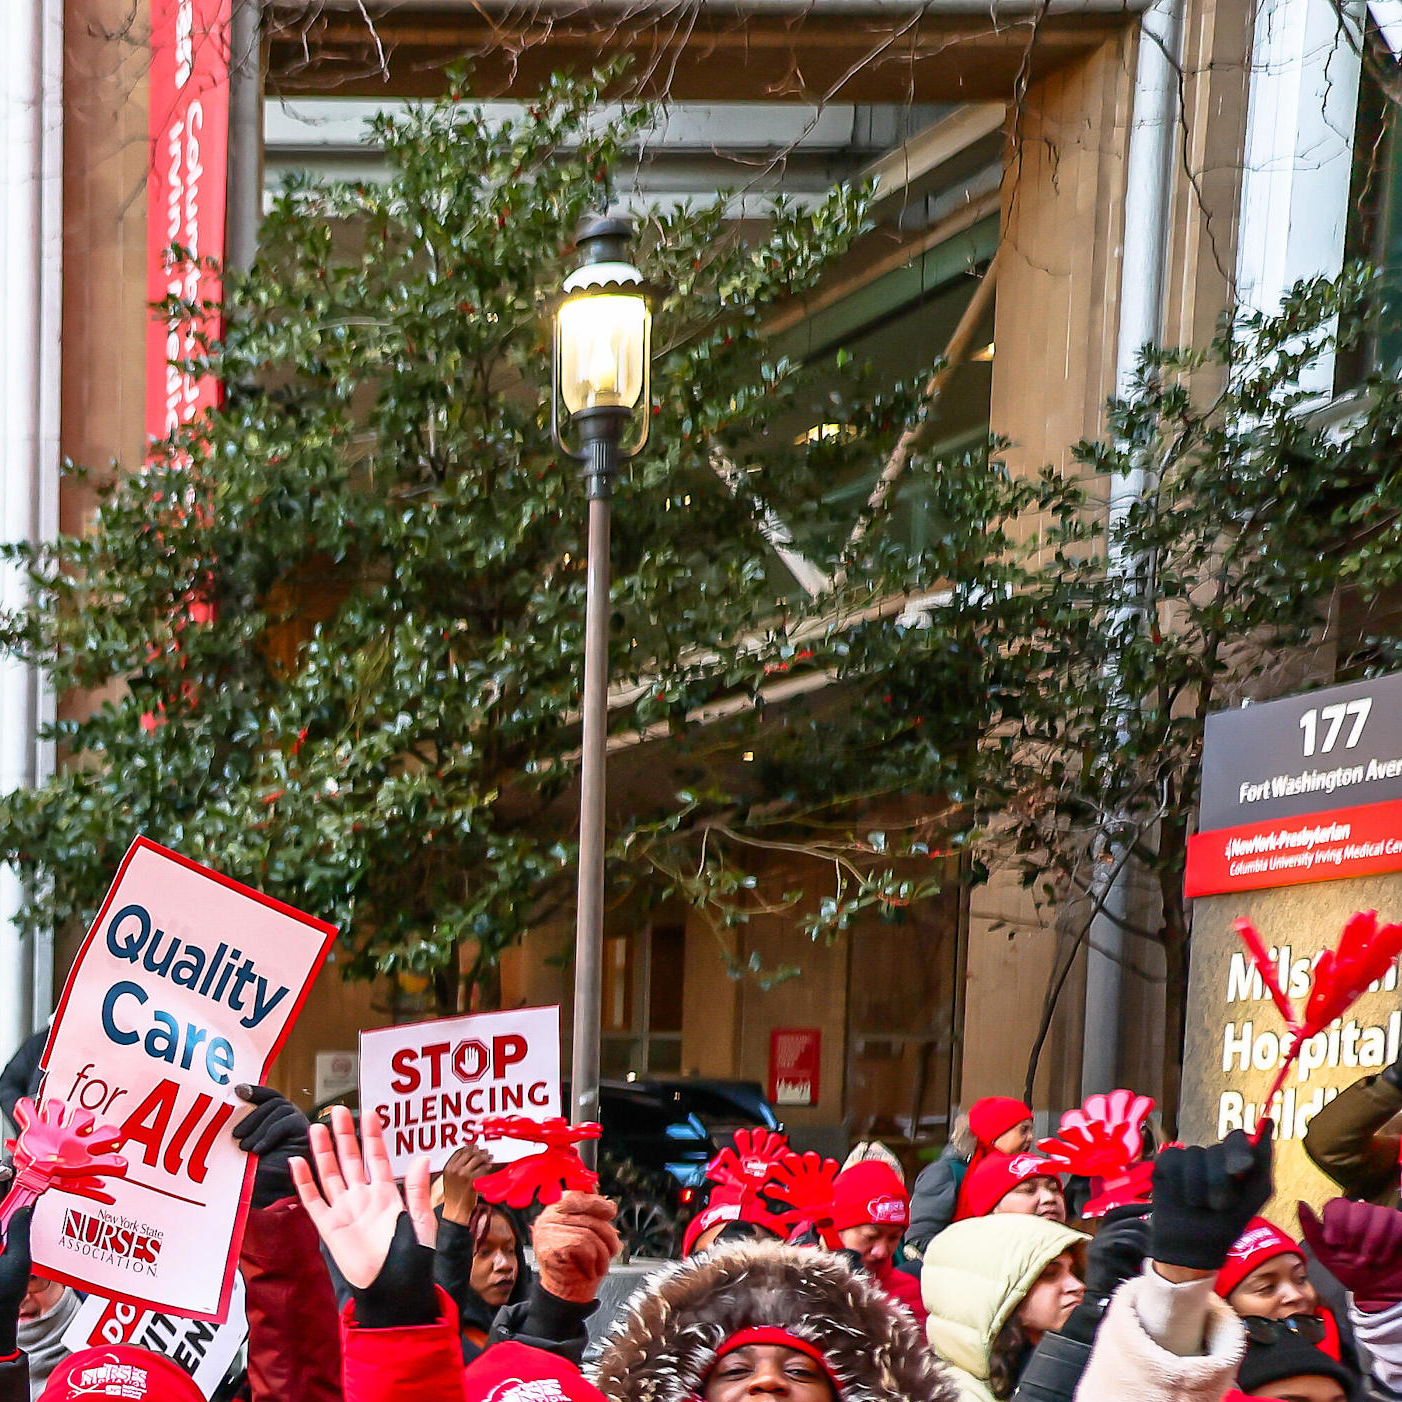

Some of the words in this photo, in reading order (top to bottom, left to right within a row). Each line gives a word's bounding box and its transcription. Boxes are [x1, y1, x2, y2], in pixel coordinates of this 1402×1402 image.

[1299, 697, 1373, 758] 177
[1239, 779, 1271, 804] Fort
[1271, 764, 1364, 799] Washington
[1229, 855, 1269, 877] Columbia
[1269, 848, 1315, 871] University
[1343, 840, 1384, 860] Medical
[106, 904, 290, 1029] Quality
[102, 980, 235, 1085] Care
[67, 1063, 128, 1116] for
[117, 1078, 236, 1184] All
[375, 1081, 550, 1130] SILENCING
[62, 1207, 163, 1264] NURSES
[97, 1208, 118, 1224] New
[120, 1215, 139, 1232] York
[140, 1223, 164, 1240] State
[58, 1235, 158, 1278] ASSOCIATION
